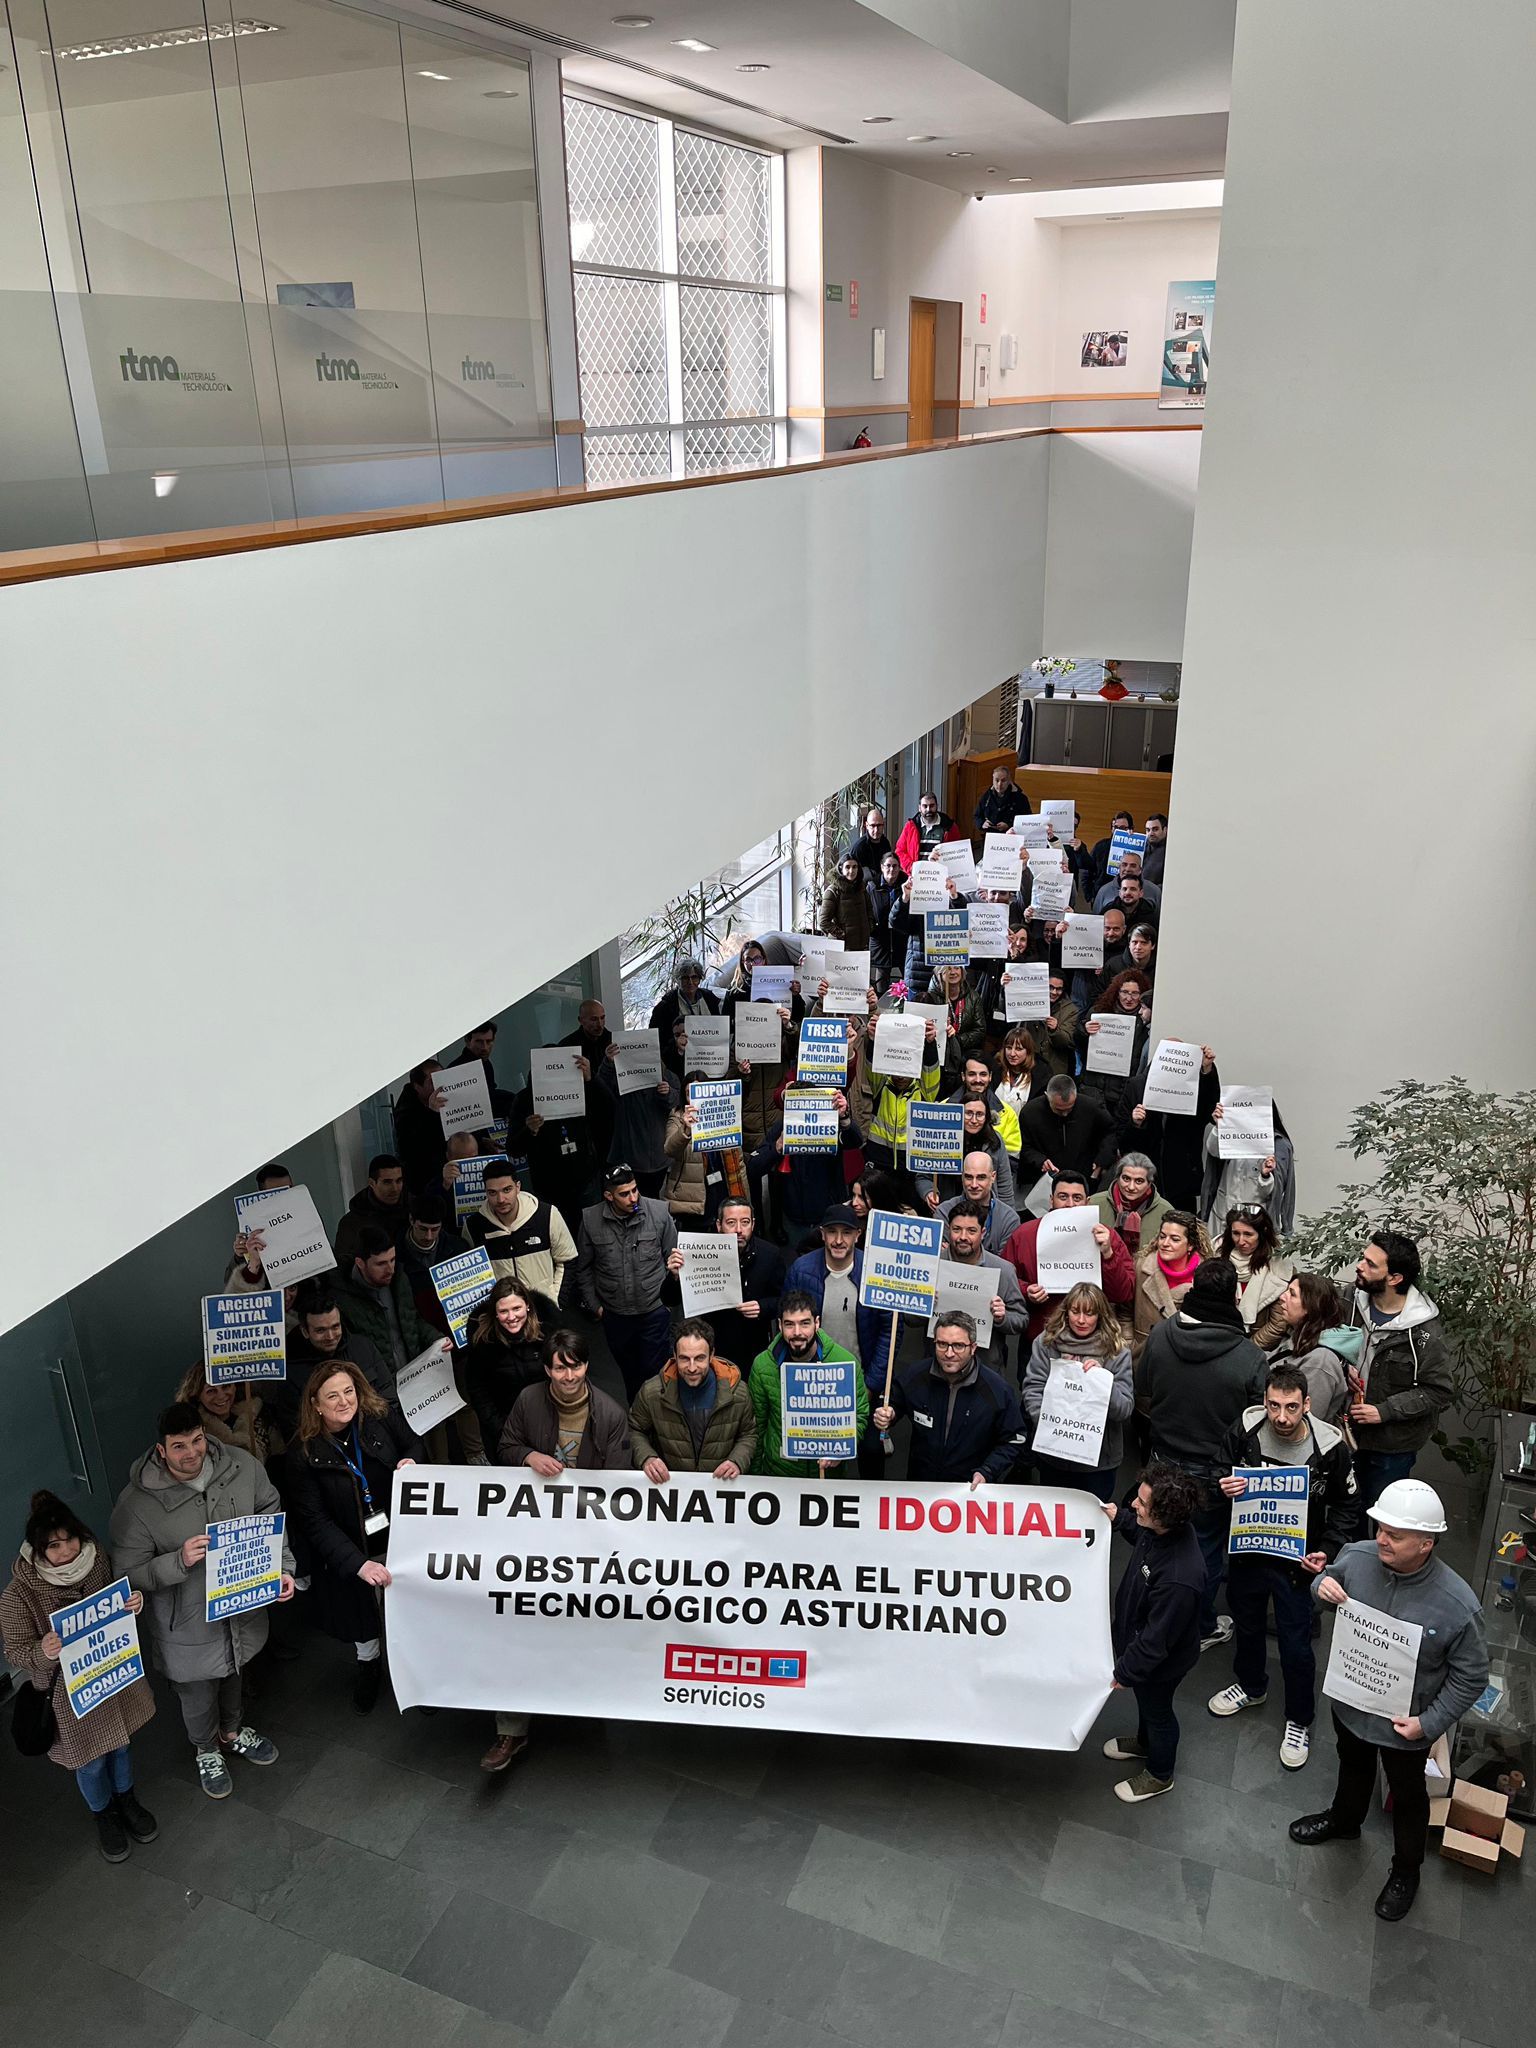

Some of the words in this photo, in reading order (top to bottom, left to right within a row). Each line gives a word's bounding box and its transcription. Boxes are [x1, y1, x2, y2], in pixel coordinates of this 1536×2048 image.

[181, 372, 216, 382] MATERIALS
[361, 373, 388, 381] MATERIALS
[183, 382, 228, 392] TECHNOLOGY
[362, 382, 396, 391] TECHNOLOGY
[933, 914, 961, 927] MBA
[935, 940, 960, 948] APARTA
[929, 955, 966, 963] IDONIAL
[807, 1023, 843, 1038] TRESA
[806, 1044, 830, 1054] APOYA
[831, 1043, 840, 1053] AL
[801, 1052, 846, 1063] PRINCIPADO
[1158, 1055, 1194, 1067] MARCELINO
[802, 1072, 843, 1081] IDONIAL
[1161, 1065, 1187, 1075] FRANCO
[546, 1093, 580, 1101] BLOQUEES
[695, 1083, 736, 1098] DUPONT
[700, 1100, 718, 1109] ¿POR
[446, 1110, 483, 1125] PRINCIPADO
[716, 1113, 725, 1121] DE
[725, 1111, 737, 1120] LOS
[804, 1112, 818, 1123] NO
[912, 1110, 961, 1121] ASTURFEITO
[702, 1119, 736, 1130] MILLONES?
[786, 1124, 837, 1136] BLOQUEES
[698, 1136, 739, 1148] IDONIAL
[947, 1130, 958, 1140] AL
[1232, 1132, 1268, 1140] BLOQUEES
[912, 1139, 960, 1150] PRINCIPADO
[914, 1160, 958, 1168] IDONIAL
[268, 1212, 294, 1228] IDESA
[879, 1220, 933, 1248] IDESA
[1054, 1225, 1078, 1233] HIASA
[266, 1260, 280, 1271] NO
[281, 1241, 323, 1265] BLOQUEES
[691, 1251, 719, 1259] NALÓN
[895, 1252, 911, 1265] NO
[436, 1251, 483, 1279] CALDERYS
[874, 1263, 930, 1282] BLOQUEES
[1053, 1263, 1094, 1271] BLOQUEES
[437, 1263, 490, 1290] RESPONSABILIDAD
[948, 1281, 979, 1291] BEZZIER
[217, 1296, 272, 1312] ARCELOR
[445, 1283, 493, 1311] CALDERYS
[871, 1288, 928, 1307] IDONIAL
[223, 1309, 268, 1324] MITTAL
[216, 1326, 261, 1341] SÚMATE
[263, 1325, 276, 1336] AL
[212, 1337, 281, 1354] PRINCIPADO
[218, 1362, 280, 1377] IDONIAL
[794, 1367, 845, 1382] ANTONIO
[803, 1380, 837, 1395] LÓPEZ
[1064, 1381, 1083, 1393] MBA
[406, 1407, 418, 1418] NO
[418, 1385, 451, 1410] BLOQUEES
[789, 1395, 852, 1409] GUARDADO
[799, 1414, 842, 1426] DIMISIÓN
[1041, 1412, 1048, 1420] SI
[1049, 1415, 1061, 1424] NO
[1062, 1417, 1103, 1435] APORTAS,
[1052, 1428, 1085, 1442] APARTA
[793, 1441, 851, 1451] IDONIAL
[1248, 1475, 1305, 1493] RASID
[1260, 1500, 1277, 1511] NO
[399, 1480, 459, 1517] EL
[476, 1482, 781, 1527] PATRONATO
[799, 1493, 860, 1530] DE
[879, 1496, 1096, 1548] IDONIAL,
[1238, 1512, 1299, 1525] BLOQUEES
[217, 1533, 236, 1548] DEL
[238, 1525, 274, 1541] NALÓN
[1236, 1536, 1300, 1551] IDONIAL
[219, 1545, 270, 1567] FELGUEROSO
[224, 1543, 247, 1557] ¿POR
[217, 1567, 228, 1577] EN
[229, 1564, 244, 1575] VEZ
[245, 1560, 255, 1569] DE
[257, 1554, 272, 1566] LOS
[218, 1577, 224, 1587] 9
[226, 1564, 271, 1585] MILLONES?
[426, 1553, 482, 1581] UN
[495, 1550, 730, 1587] OBSTÁCULO
[743, 1561, 842, 1592] PARA
[856, 1565, 900, 1594] EL
[914, 1568, 1072, 1603] FUTURO
[214, 1585, 276, 1612] IDONIAL
[61, 1590, 126, 1639] HIASA
[488, 1588, 768, 1625] TECNOLÓGICO
[780, 1598, 1007, 1637] ASTURIANO
[1337, 1606, 1390, 1637] CERÁMICA
[1391, 1632, 1412, 1647] DEL
[88, 1630, 106, 1648] NO
[1353, 1628, 1390, 1650] NALÓN
[69, 1633, 131, 1676] BLOQUEES
[1350, 1647, 1370, 1660] ¿POR
[670, 1650, 761, 1677] CCOO
[1338, 1649, 1387, 1678] FELGUEROSO
[1388, 1673, 1400, 1682] EN
[1343, 1662, 1357, 1672] VEZ
[1358, 1670, 1368, 1679] DE
[1369, 1677, 1385, 1686] LOS
[77, 1662, 138, 1705] IDONIAL
[1344, 1672, 1388, 1696] MILLONES?
[662, 1684, 766, 1709] servicios
